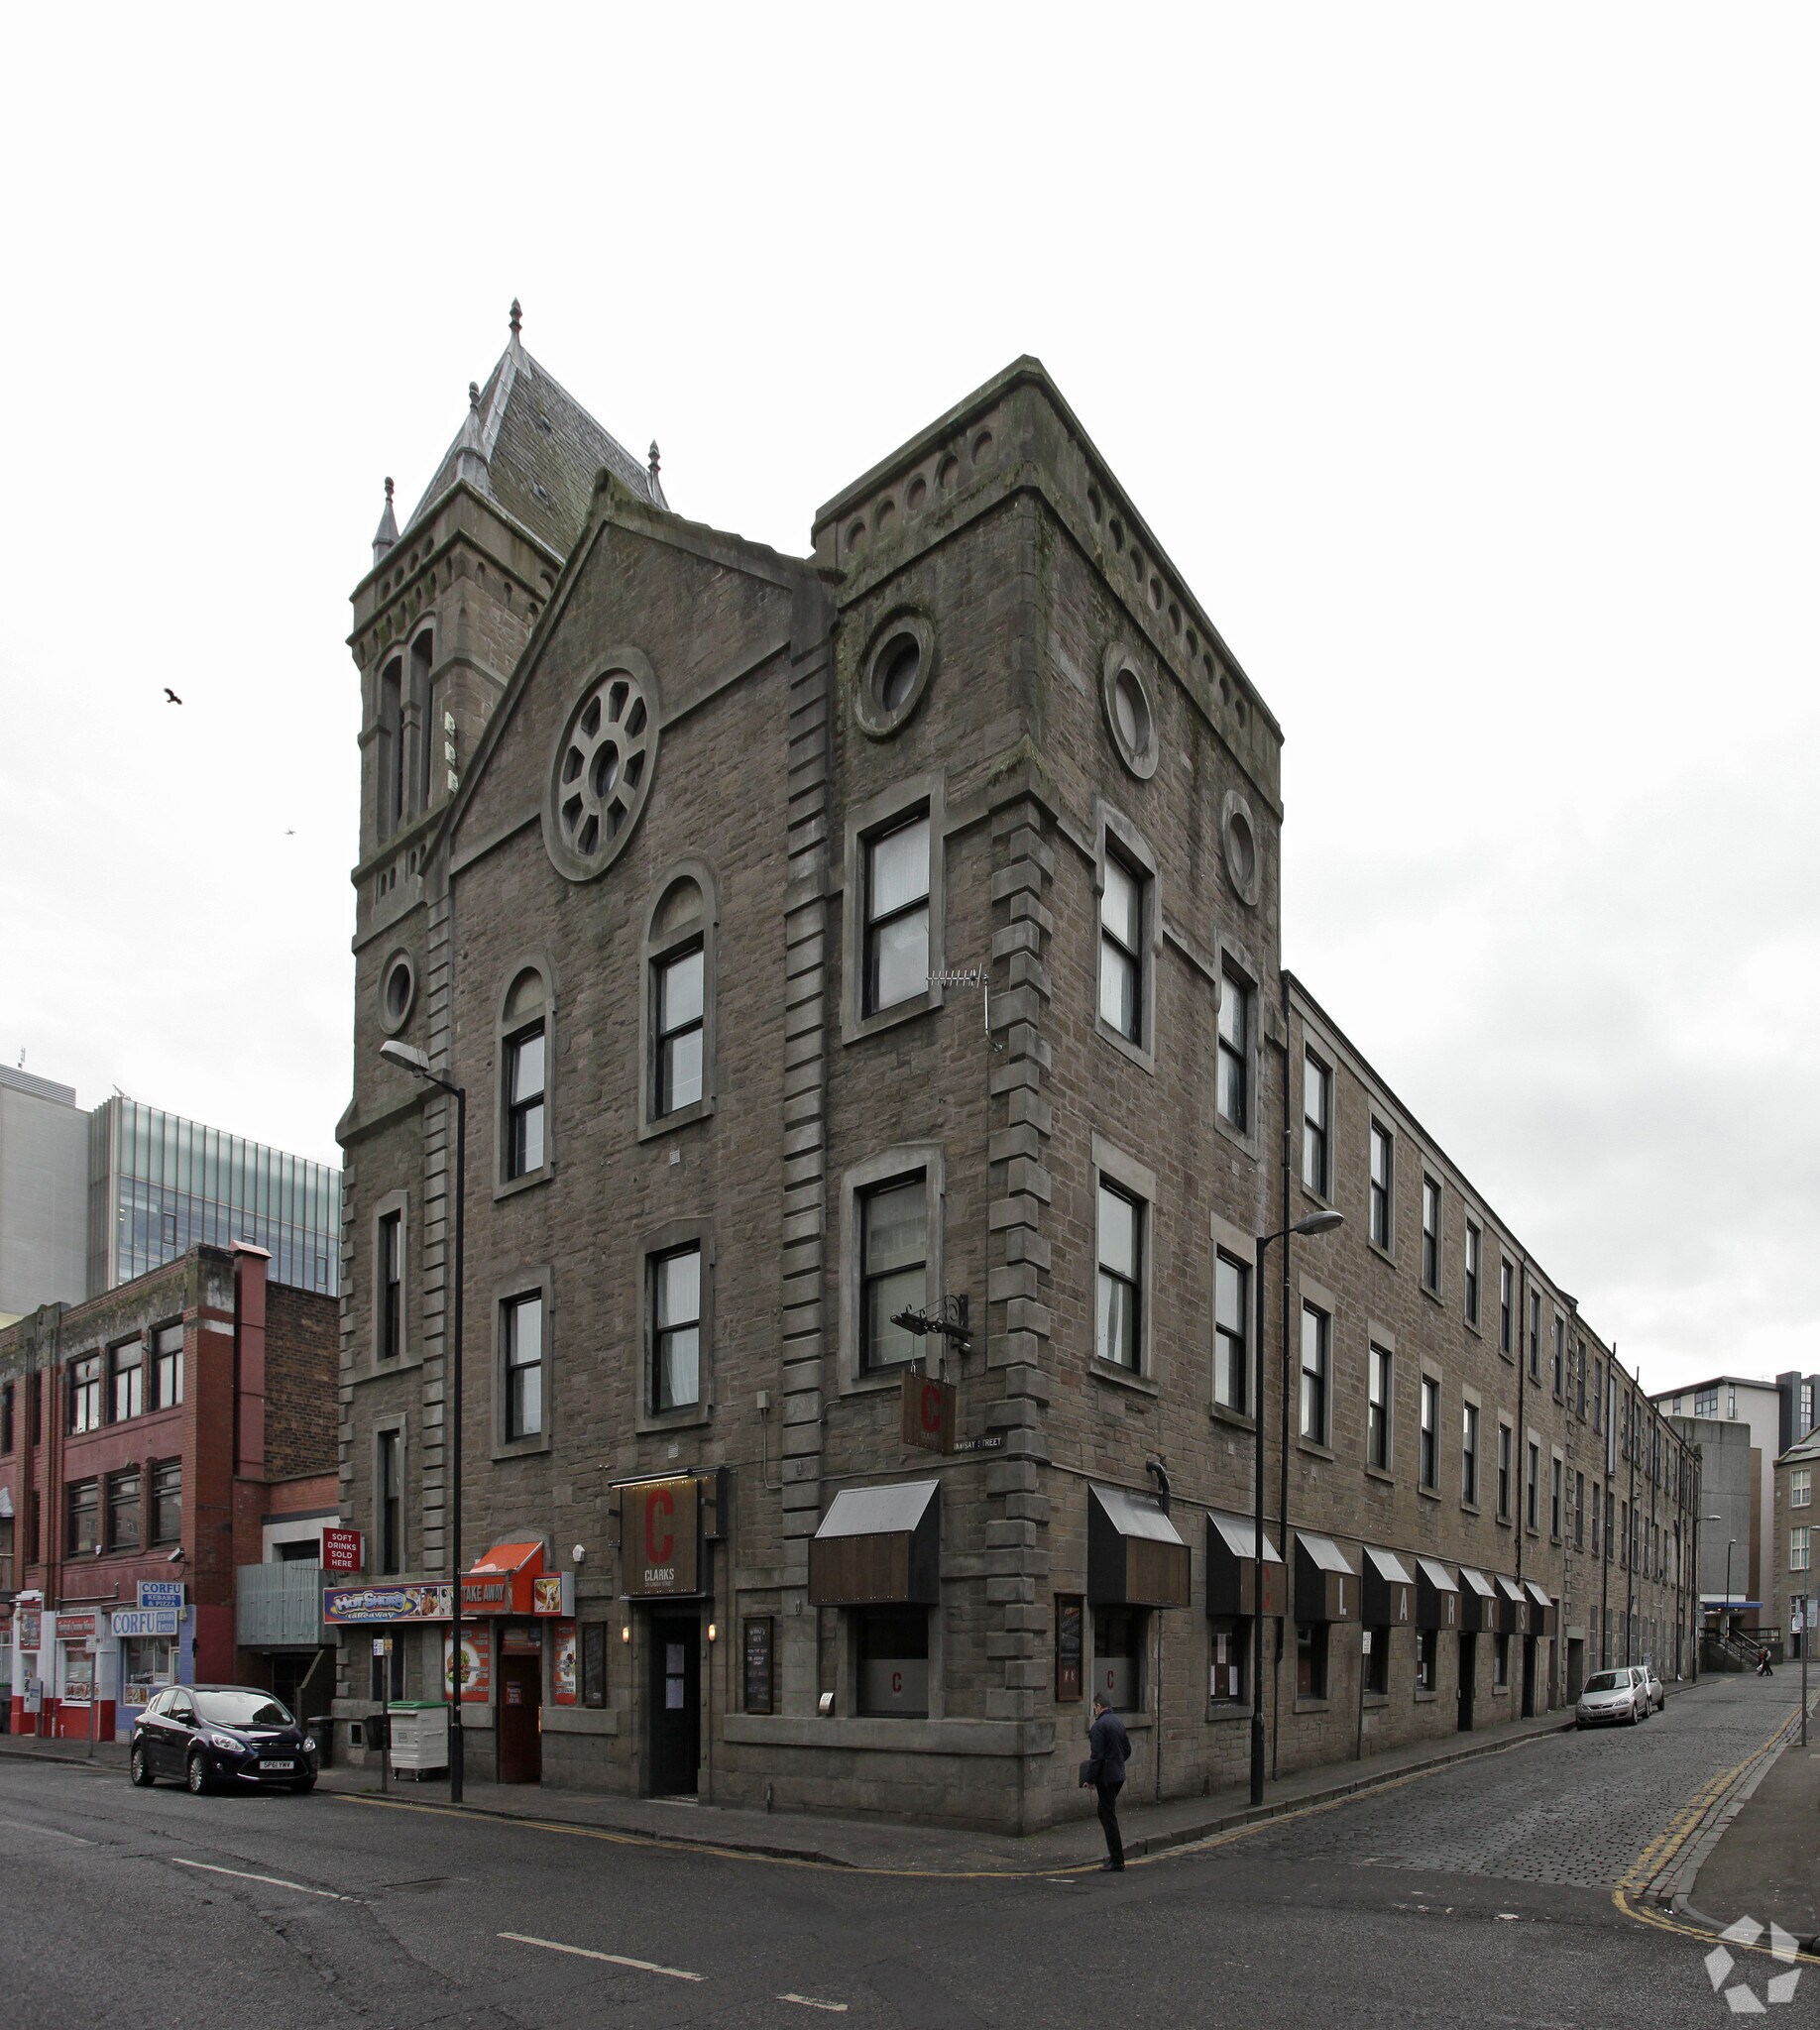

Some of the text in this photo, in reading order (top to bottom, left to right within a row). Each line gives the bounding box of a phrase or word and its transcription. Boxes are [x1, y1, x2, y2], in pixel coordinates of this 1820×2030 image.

[921, 1384, 941, 1432] C
[644, 1489, 674, 1563] C
[327, 1541, 357, 1551] DRINKS
[331, 1550, 353, 1559] SOLD
[331, 1559, 353, 1568] HERE
[644, 1568, 674, 1581] CLARKS
[142, 1583, 181, 1593] CORFU
[460, 1584, 505, 1602] TAKE AWAY
[347, 1610, 395, 1620] takeaway
[113, 1613, 156, 1634] CORFU
[892, 1672, 902, 1693] C
[1107, 1670, 1114, 1689] C
